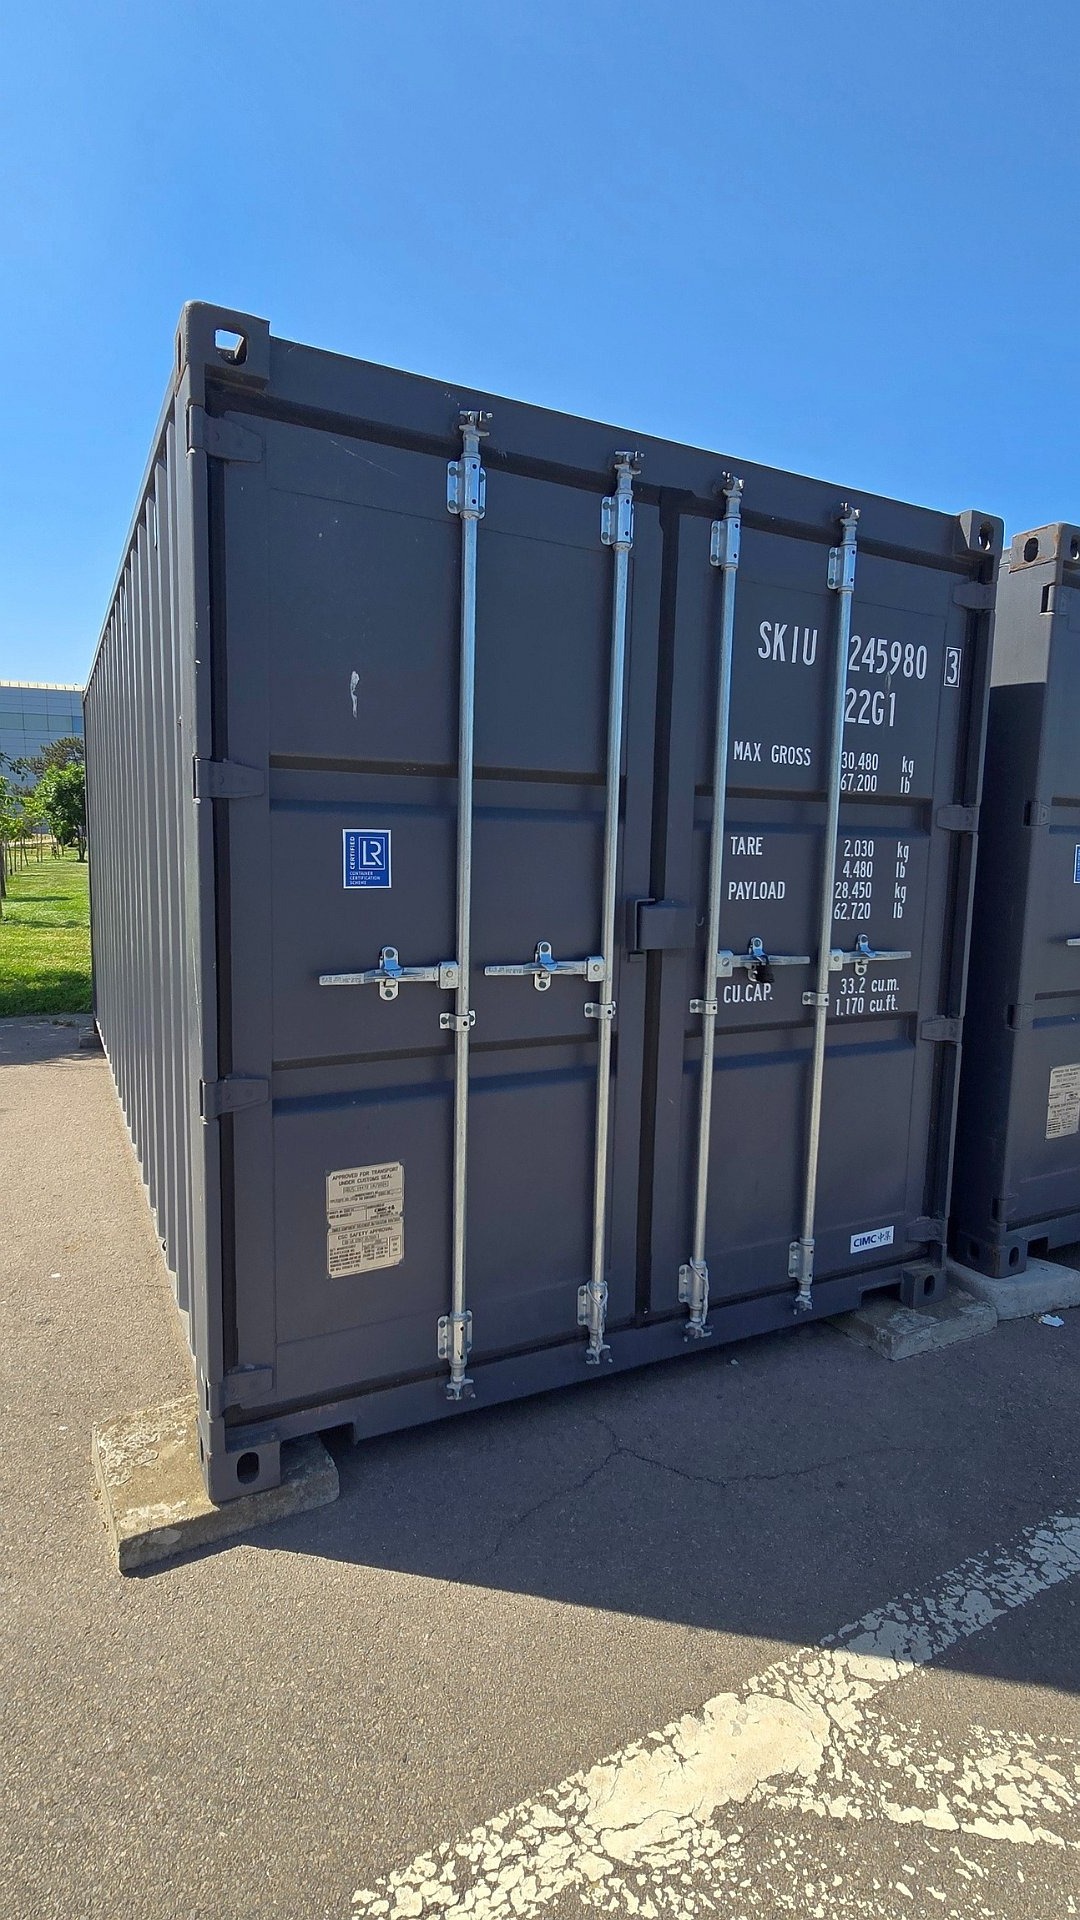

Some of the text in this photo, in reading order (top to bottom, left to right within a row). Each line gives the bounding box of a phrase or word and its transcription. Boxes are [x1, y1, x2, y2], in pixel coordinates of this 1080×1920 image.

[757, 621, 959, 684] SKIU 245980 3
[844, 687, 896, 727] 22G1
[733, 741, 762, 762] MAX
[771, 745, 811, 766] GROSS
[901, 755, 914, 777] kg
[900, 776, 910, 794] lb
[362, 840, 383, 866] LR
[730, 836, 763, 856] TARE
[896, 841, 909, 863] kg
[895, 861, 906, 878] lb
[728, 881, 786, 900] PAYLOAD
[894, 882, 907, 904] kg
[893, 902, 903, 919] lb
[723, 977, 900, 1004] CU.CAP. 33.2 cu.m.
[869, 994, 898, 1012] cu.ft.
[331, 1172, 359, 1181] APPROVED
[371, 1166, 399, 1175] TRANSPORT
[349, 1230, 368, 1238] SAFETY
[369, 1226, 394, 1234] APPROVAL
[853, 1234, 877, 1247] CIMC
